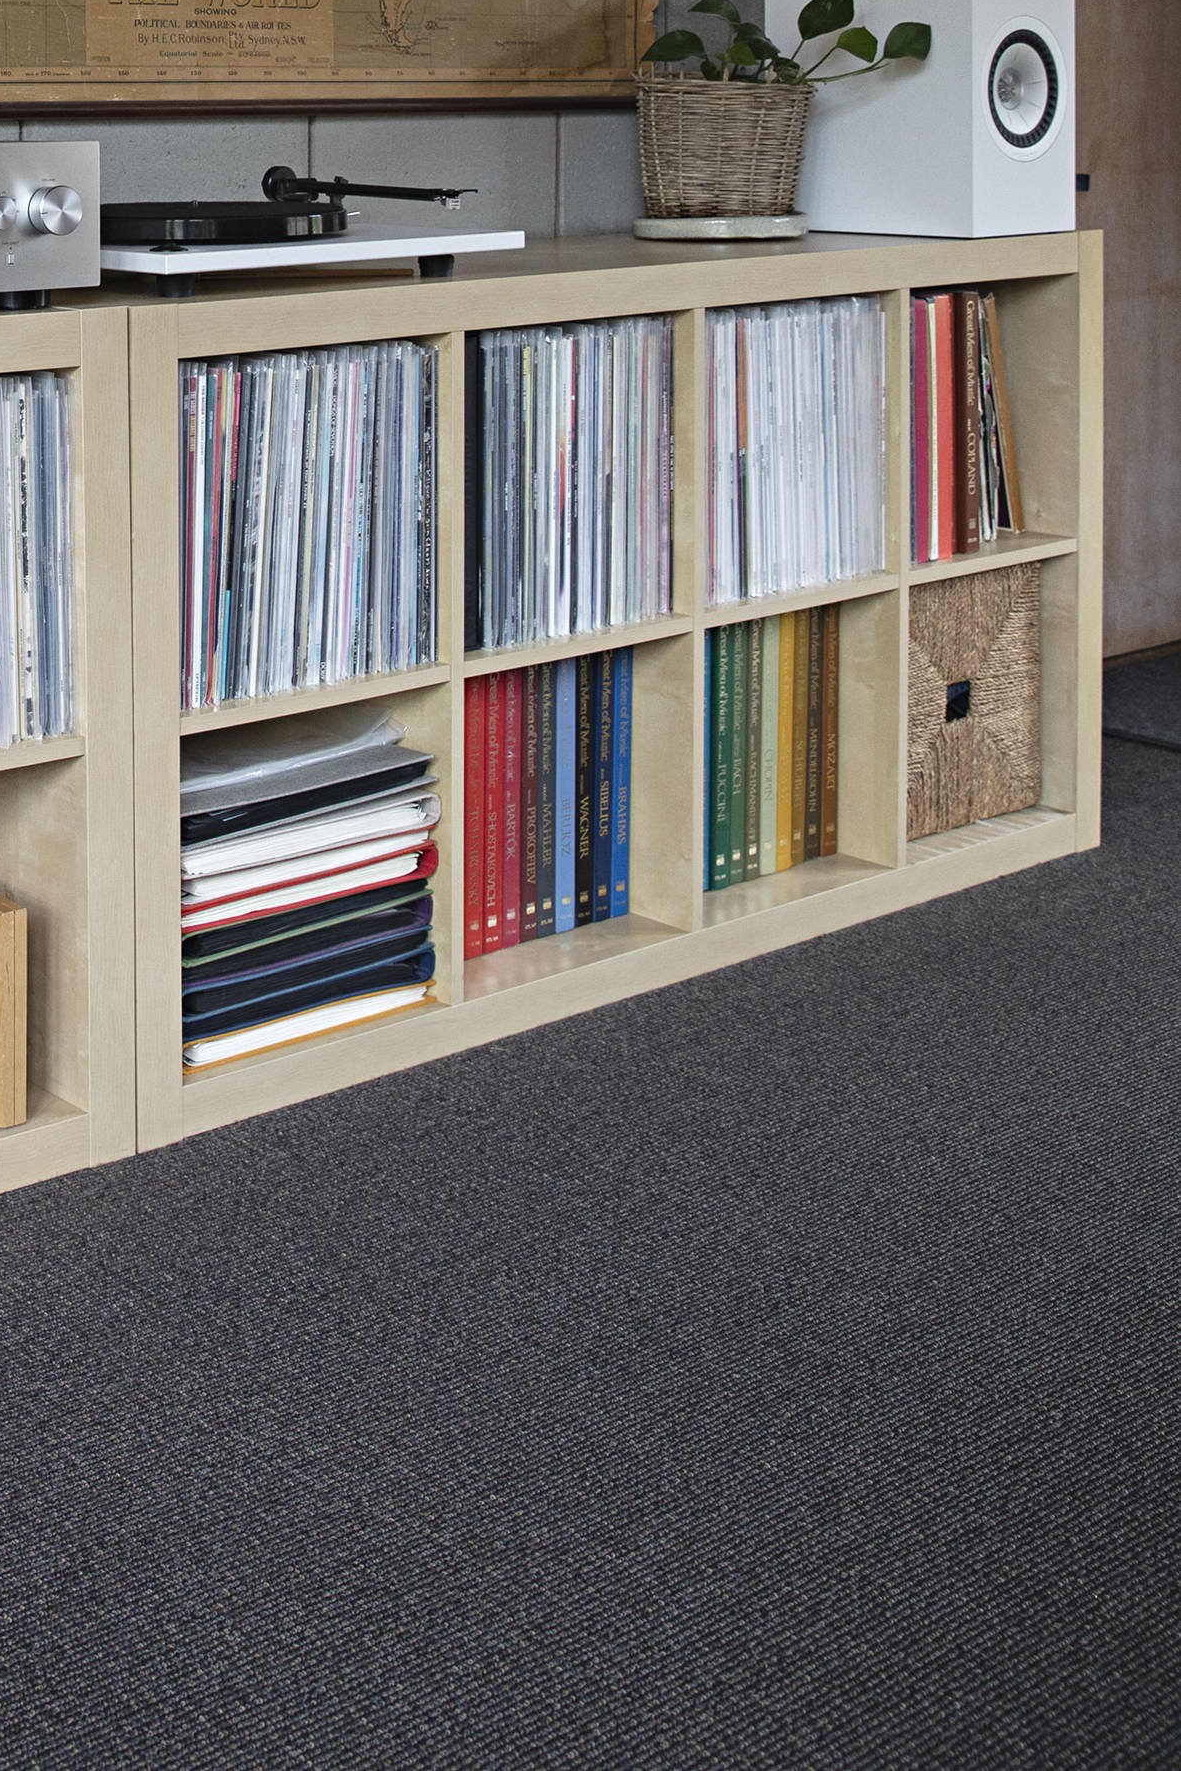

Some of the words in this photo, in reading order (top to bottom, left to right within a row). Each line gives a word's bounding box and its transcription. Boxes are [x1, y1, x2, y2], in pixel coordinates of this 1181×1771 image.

[134, 19, 180, 28] POLITICAL
[185, 20, 236, 29] BOUNDARIES
[138, 34, 148, 45] By
[194, 8, 237, 16] SHOWING
[967, 433, 976, 494] COPLAND
[732, 758, 742, 795] BACH
[826, 733, 835, 790] MOZART
[599, 780, 610, 837] SIBELIUS
[617, 785, 627, 845] BRAHMS
[716, 764, 727, 823] PUCCINI
[526, 806, 537, 885] PROKOFIEV
[542, 803, 552, 868] MAHLER
[579, 796, 590, 860] WAGNER
[486, 811, 497, 908] SHOSTAKOVICH
